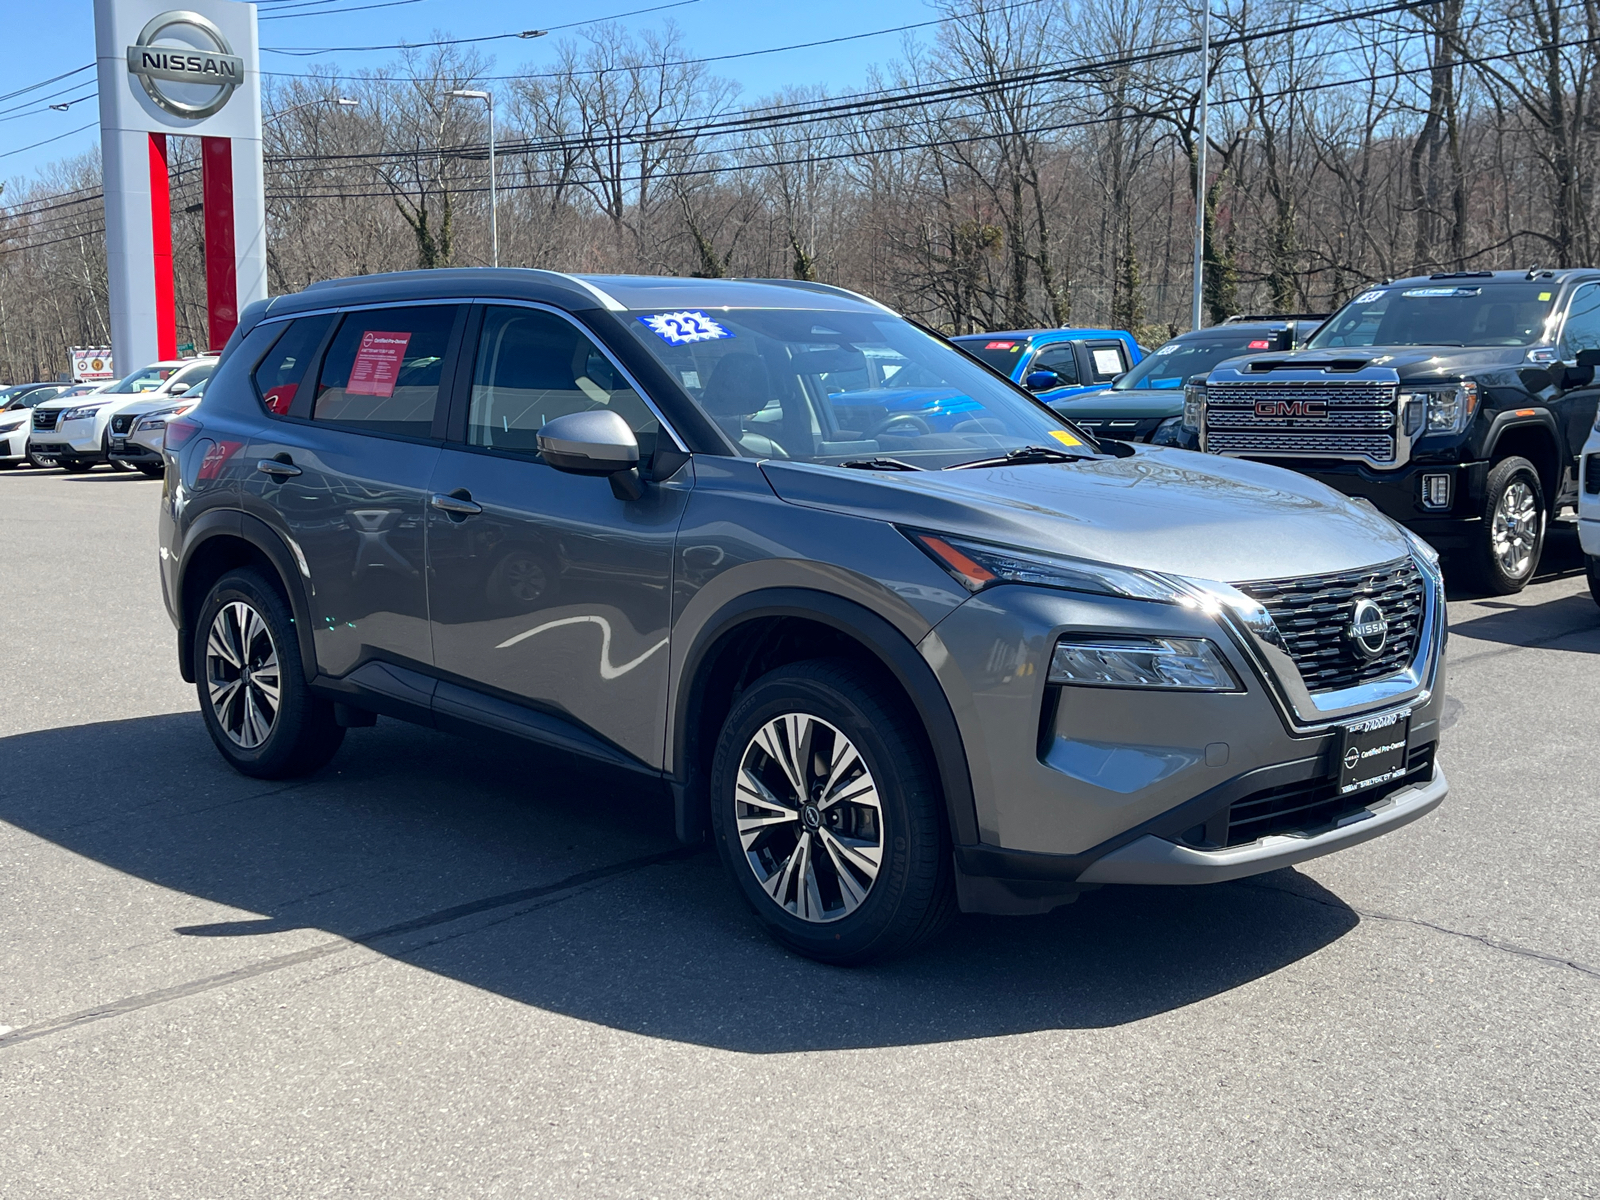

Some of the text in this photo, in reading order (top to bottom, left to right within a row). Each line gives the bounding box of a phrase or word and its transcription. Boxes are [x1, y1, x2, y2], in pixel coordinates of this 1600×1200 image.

[142, 52, 235, 77] NISSAN
[664, 316, 710, 337] 22
[1255, 401, 1327, 416] GMC
[1352, 621, 1388, 636] NISSAN
[733, 695, 757, 724] CROSS
[1361, 746, 1381, 758] Certified
[1382, 739, 1406, 752] Pre-Owned
[711, 720, 737, 830] VELOCITY
